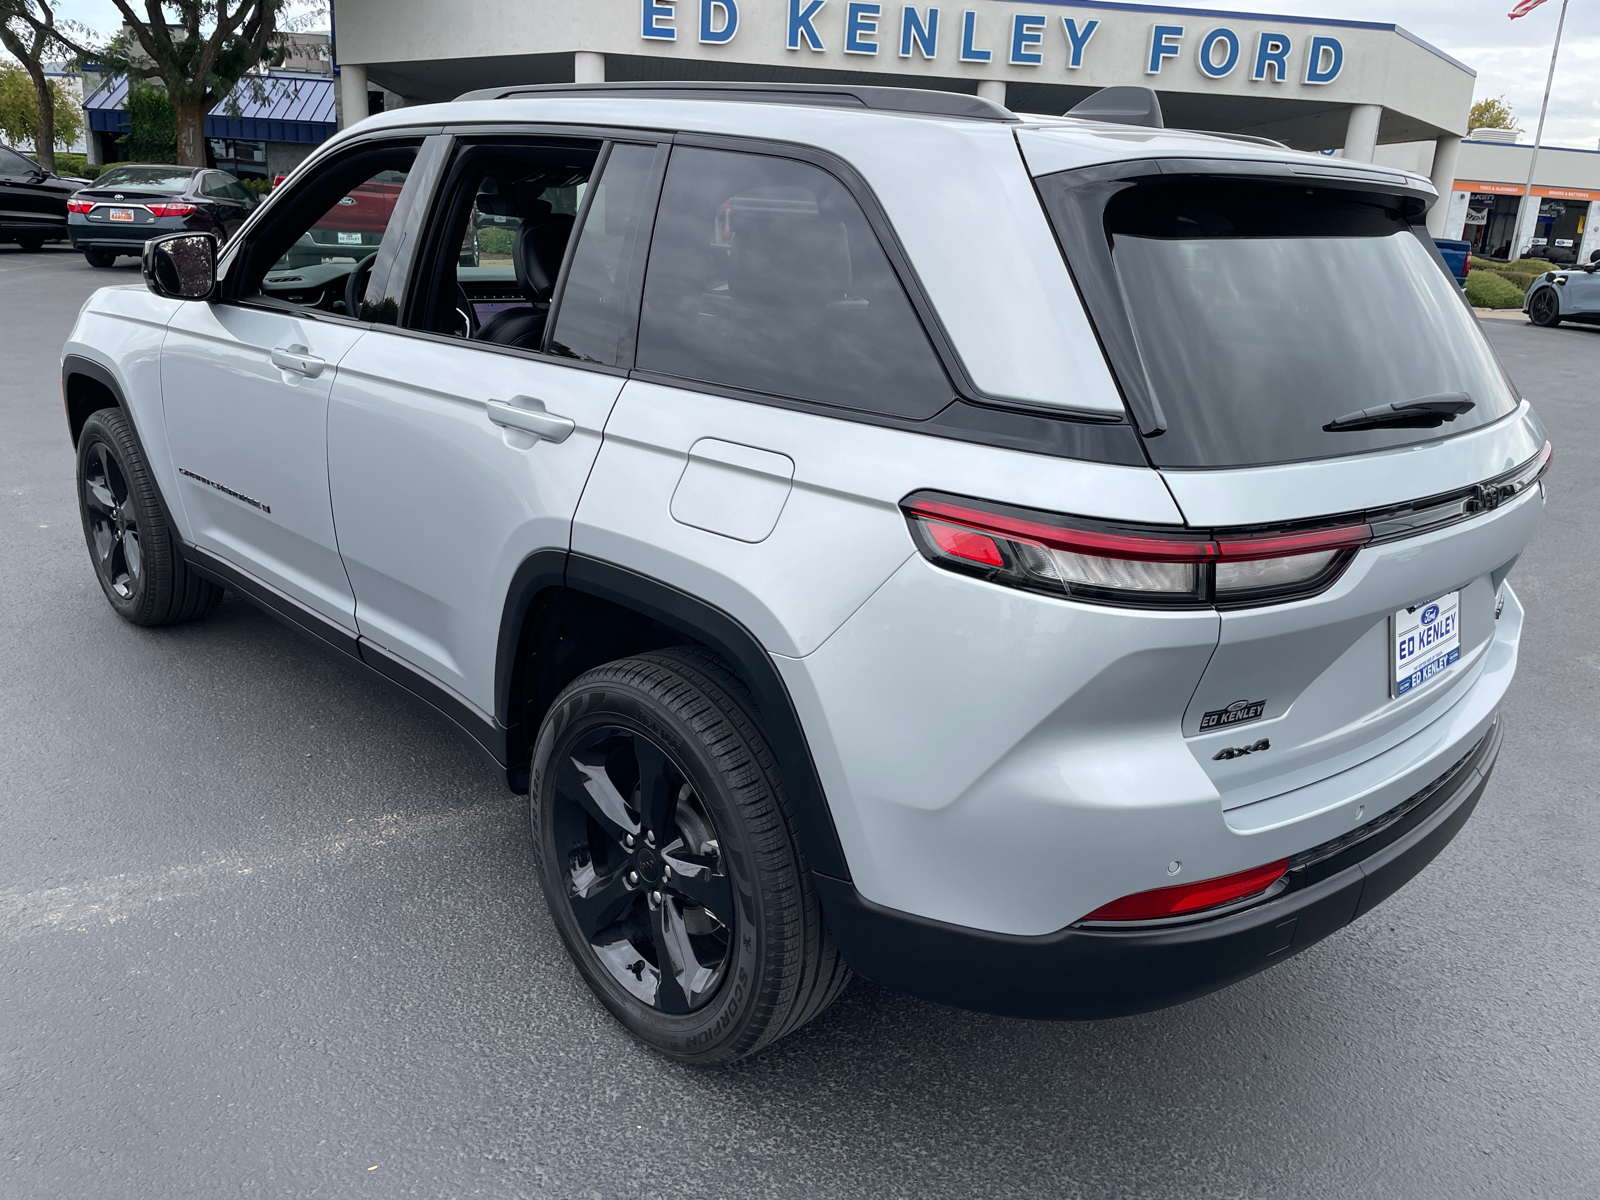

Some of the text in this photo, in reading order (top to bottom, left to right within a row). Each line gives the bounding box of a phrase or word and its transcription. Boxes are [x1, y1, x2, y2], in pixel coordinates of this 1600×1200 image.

[641, 0, 1344, 85] ED KENLEY FORD
[1399, 612, 1457, 660] ED KENLEY
[1424, 608, 1437, 623] Ford
[1411, 670, 1422, 688] ED
[1422, 654, 1449, 681] KENLEY
[1201, 704, 1264, 727] ED KENLEY
[685, 966, 749, 1048] SCORPION
